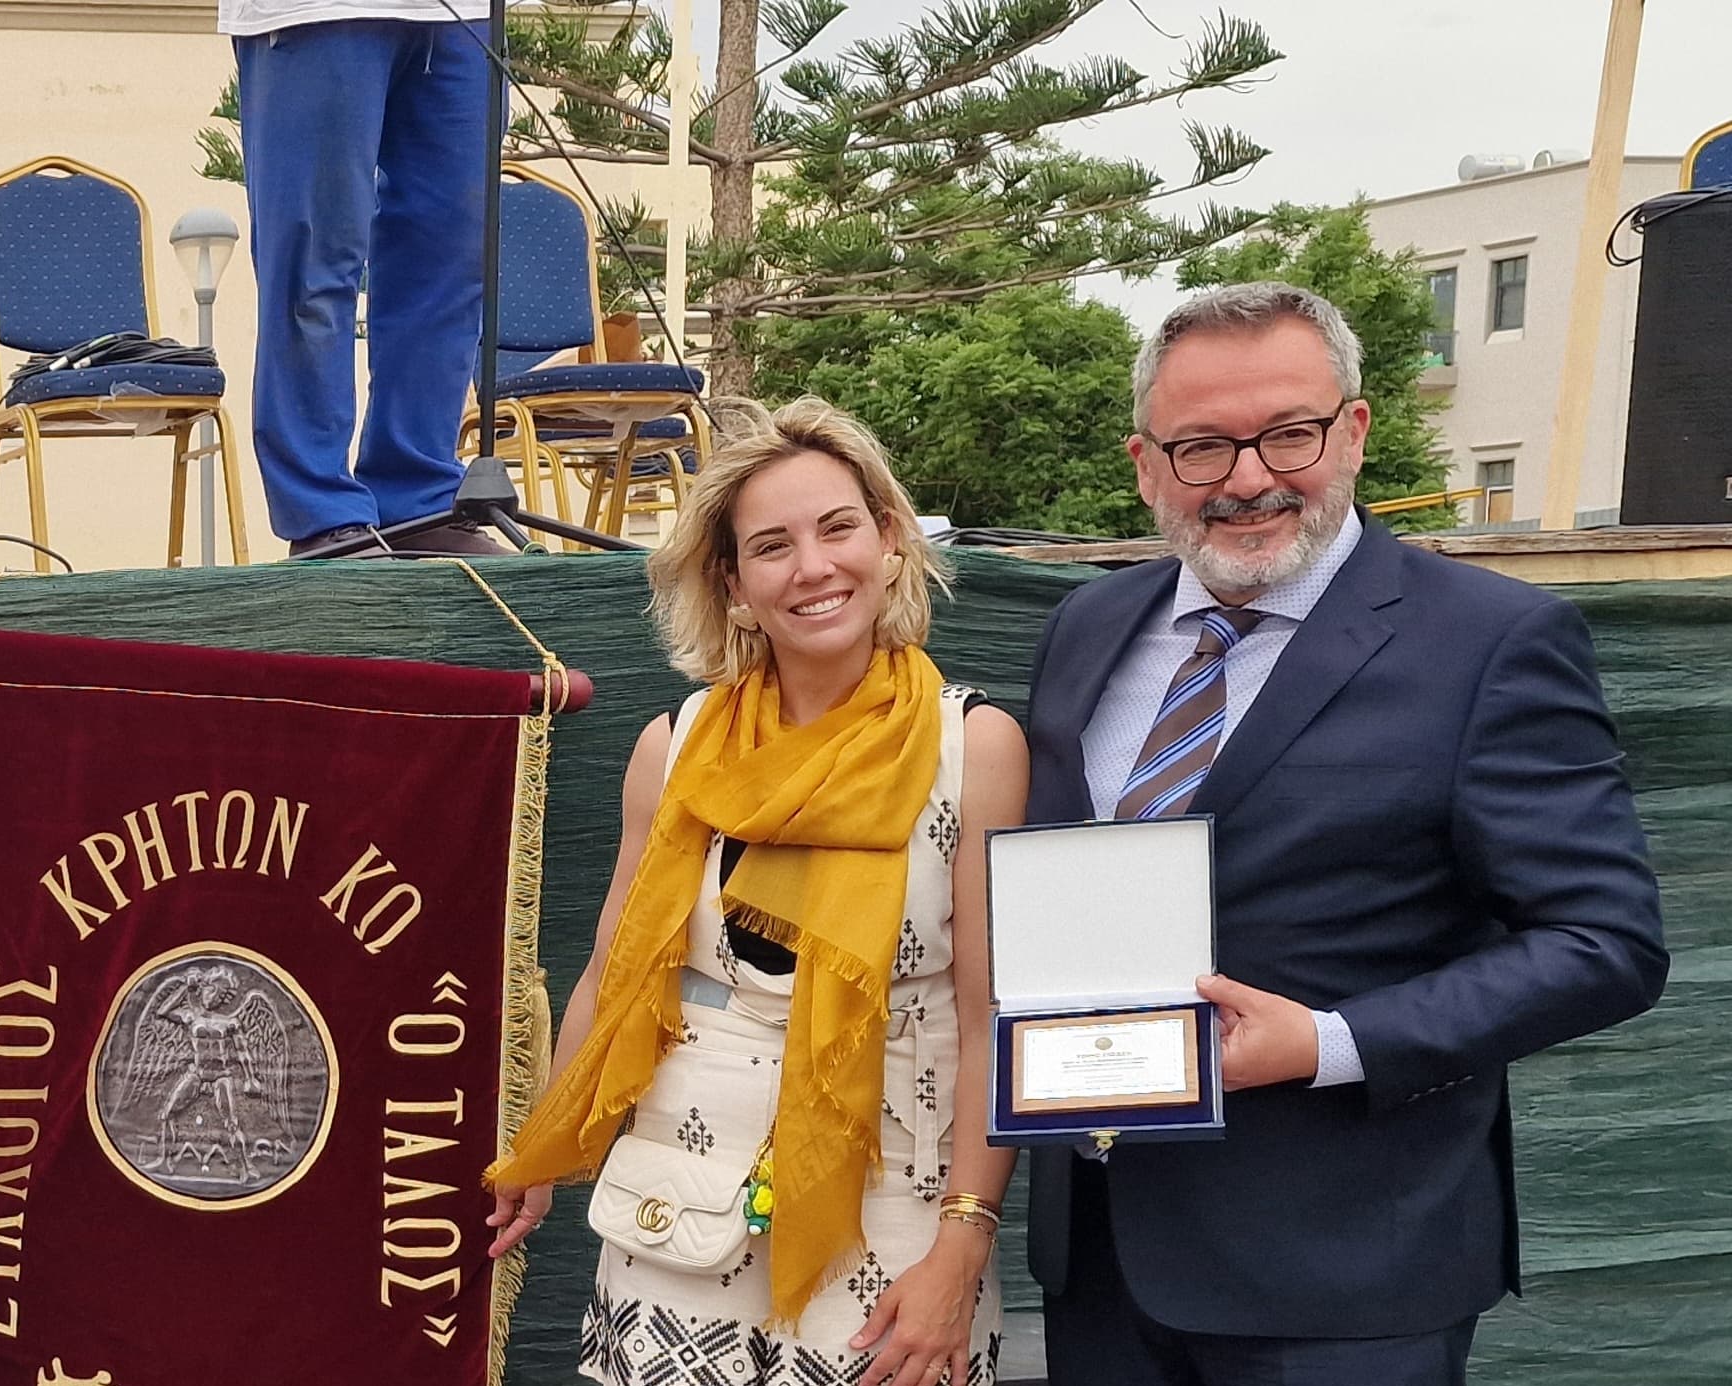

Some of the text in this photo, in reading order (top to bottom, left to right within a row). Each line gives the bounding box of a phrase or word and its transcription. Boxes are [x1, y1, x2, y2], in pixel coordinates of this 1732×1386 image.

[40, 790, 309, 940] ΚΡΗΤΩΝ
[319, 843, 421, 954] ΚΩ
[381, 1088, 464, 1347] ΤΑΛΩΣ»
